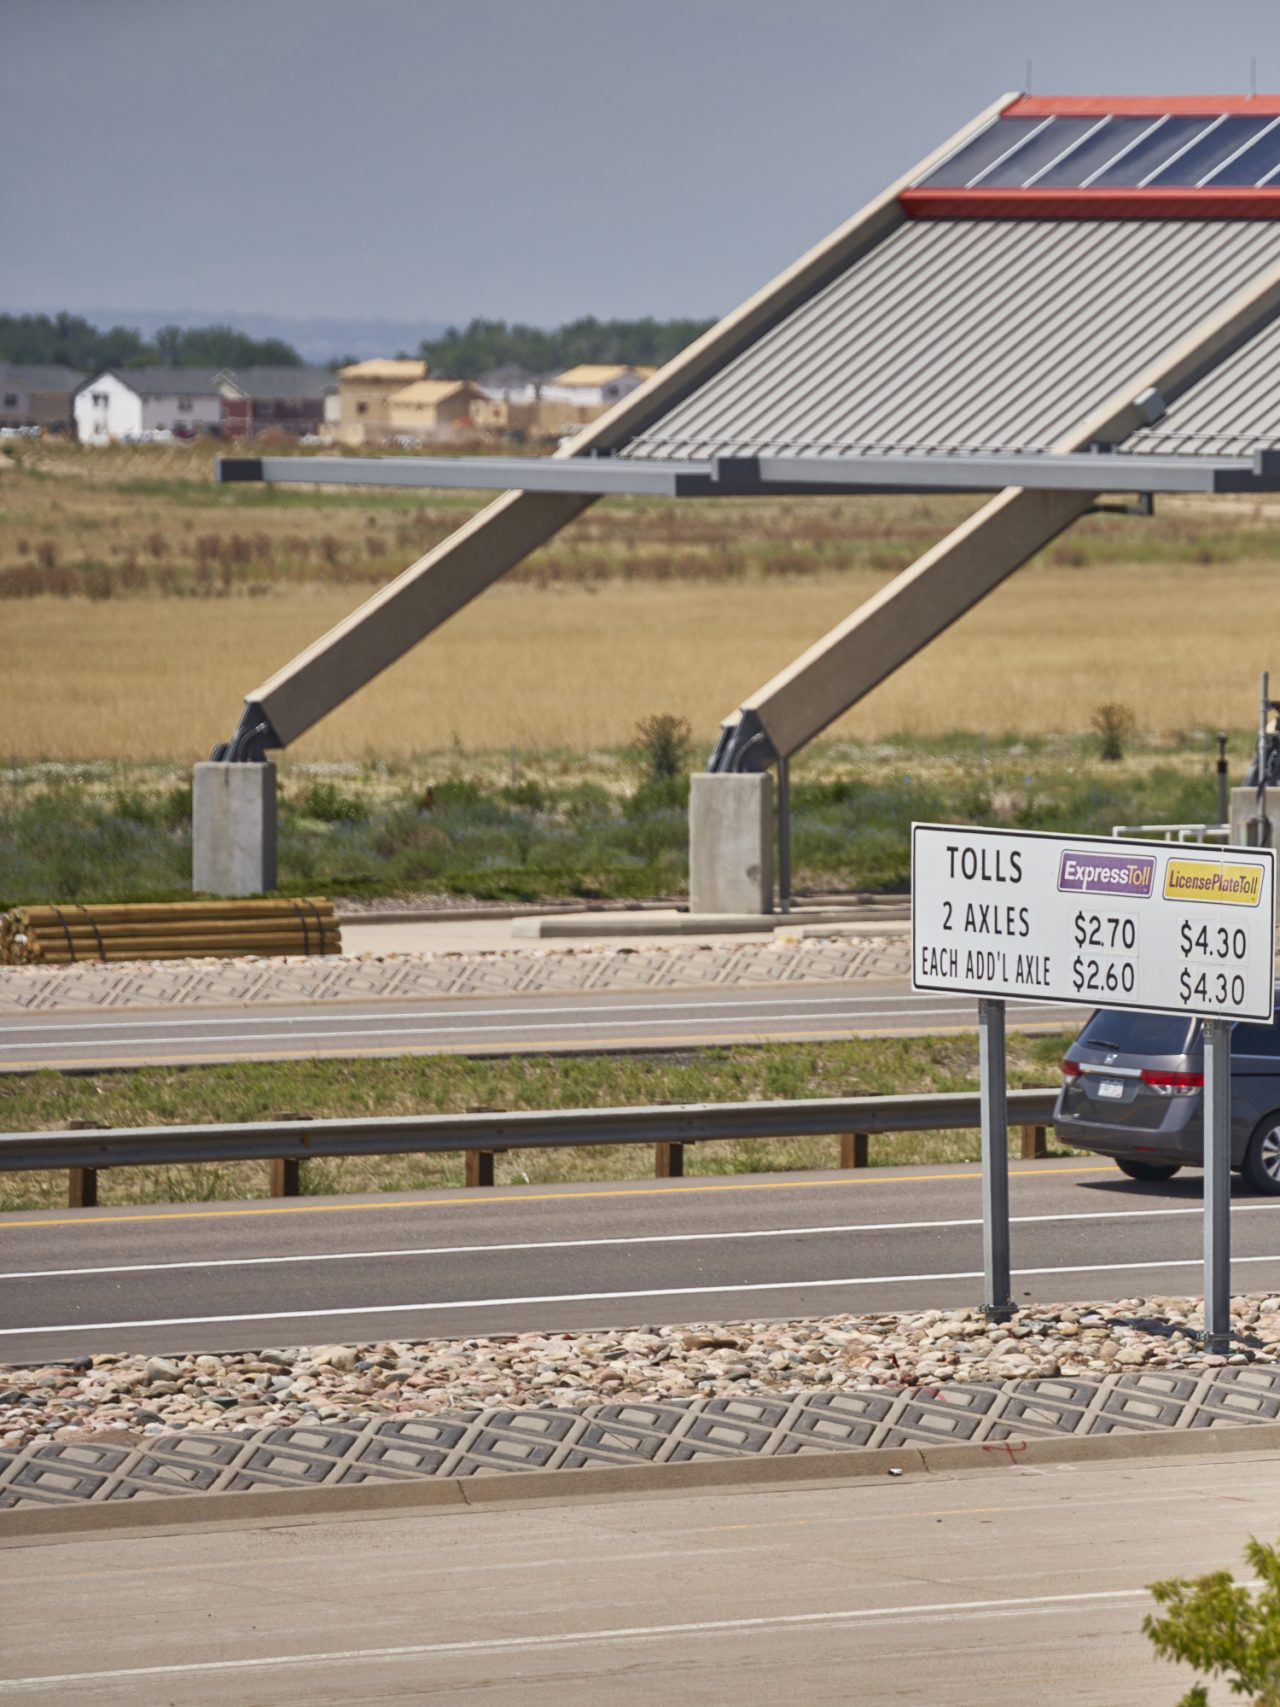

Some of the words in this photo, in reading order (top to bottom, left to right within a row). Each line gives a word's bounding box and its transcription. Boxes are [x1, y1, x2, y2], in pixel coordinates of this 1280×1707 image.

[946, 846, 1022, 883] TOLLS
[1064, 860, 1151, 890] ExpressToll
[1169, 870, 1258, 894] LicensePlateToll
[942, 901, 953, 930] 2
[965, 902, 1030, 937] AXLES
[1074, 910, 1136, 949] $2.70
[1180, 919, 1247, 959] $4.30
[922, 946, 958, 978] EACH
[965, 951, 1009, 983] ADD'L
[1015, 954, 1050, 986] AXLE
[1072, 955, 1135, 992] $2.60
[1179, 966, 1245, 1005] $4.30
